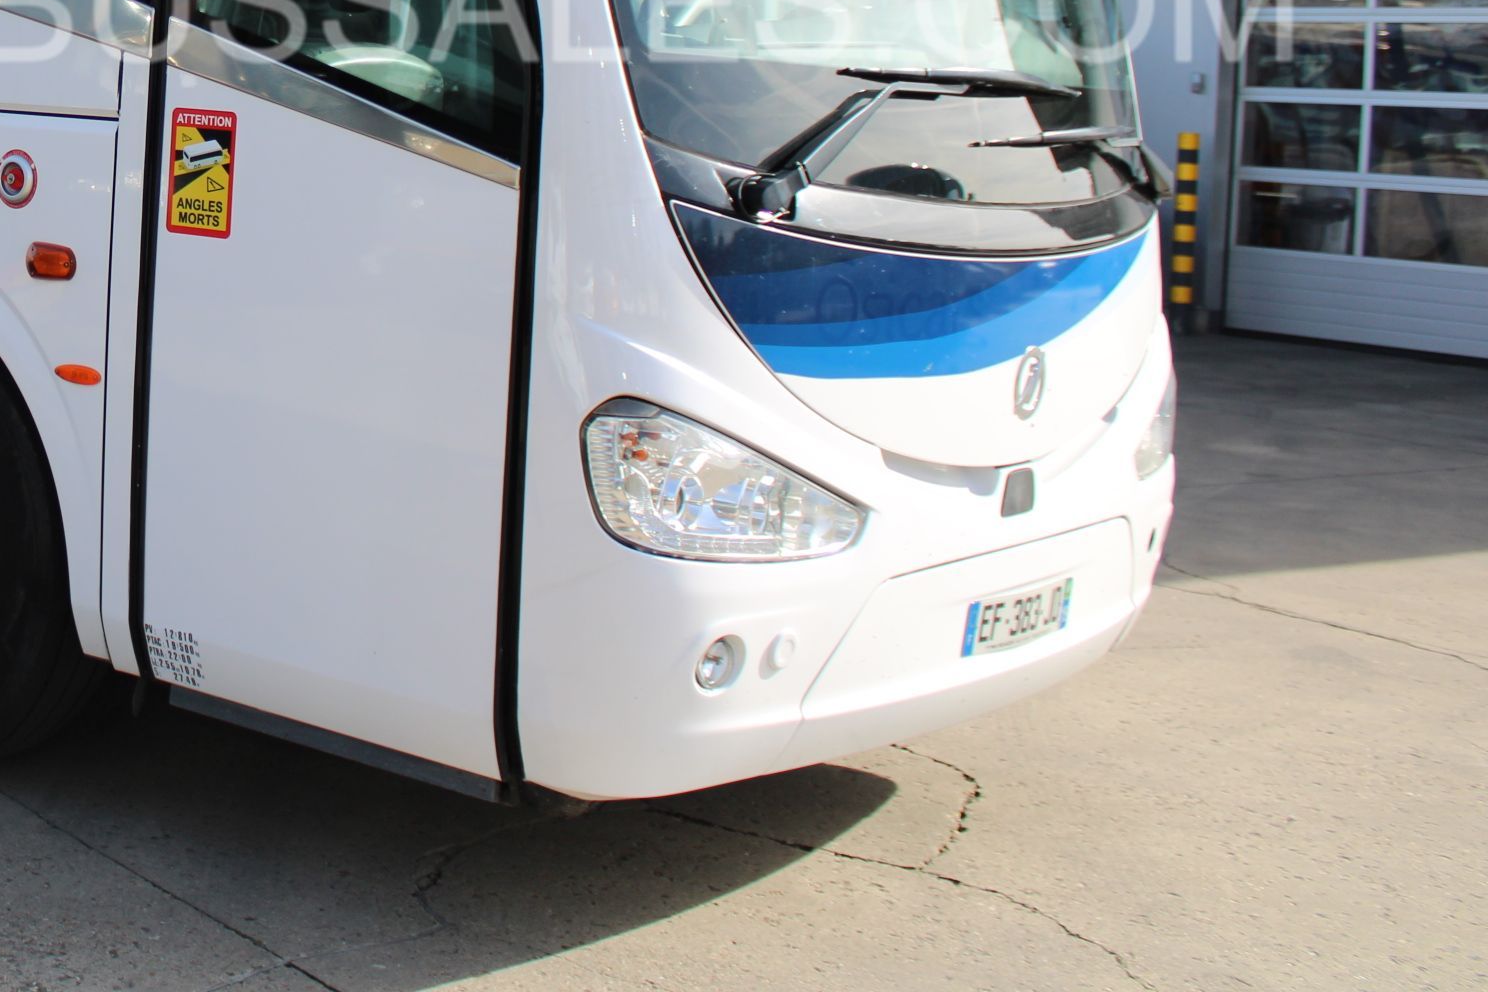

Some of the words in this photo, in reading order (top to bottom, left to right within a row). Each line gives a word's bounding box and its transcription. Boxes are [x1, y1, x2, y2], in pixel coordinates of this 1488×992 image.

[176, 113, 232, 128] ATTENTION
[176, 197, 223, 213] ANGLES
[178, 211, 220, 227] MORTS
